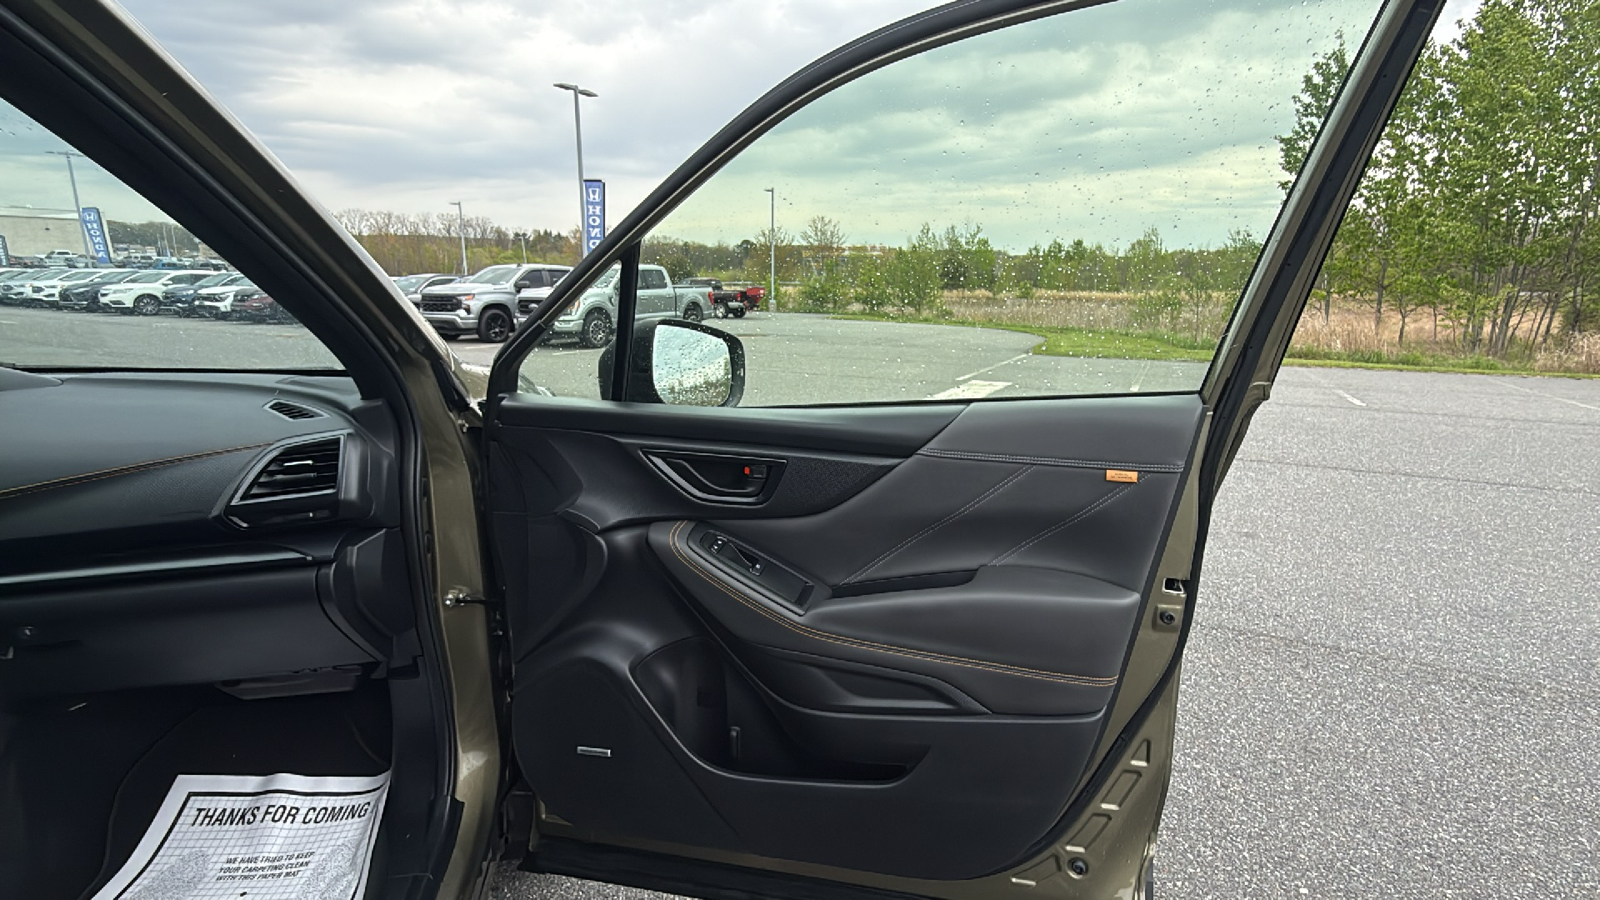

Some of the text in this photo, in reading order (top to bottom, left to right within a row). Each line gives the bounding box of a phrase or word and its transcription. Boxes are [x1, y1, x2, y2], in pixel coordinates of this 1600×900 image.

[191, 801, 371, 827] THANKS FOR COMING
[226, 851, 315, 864] WE HAVE TRIED TO KEEP
[219, 860, 310, 874] YOUR CARPETING CLEAN
[257, 872, 283, 880] PAPER
[283, 869, 303, 878] MAT
